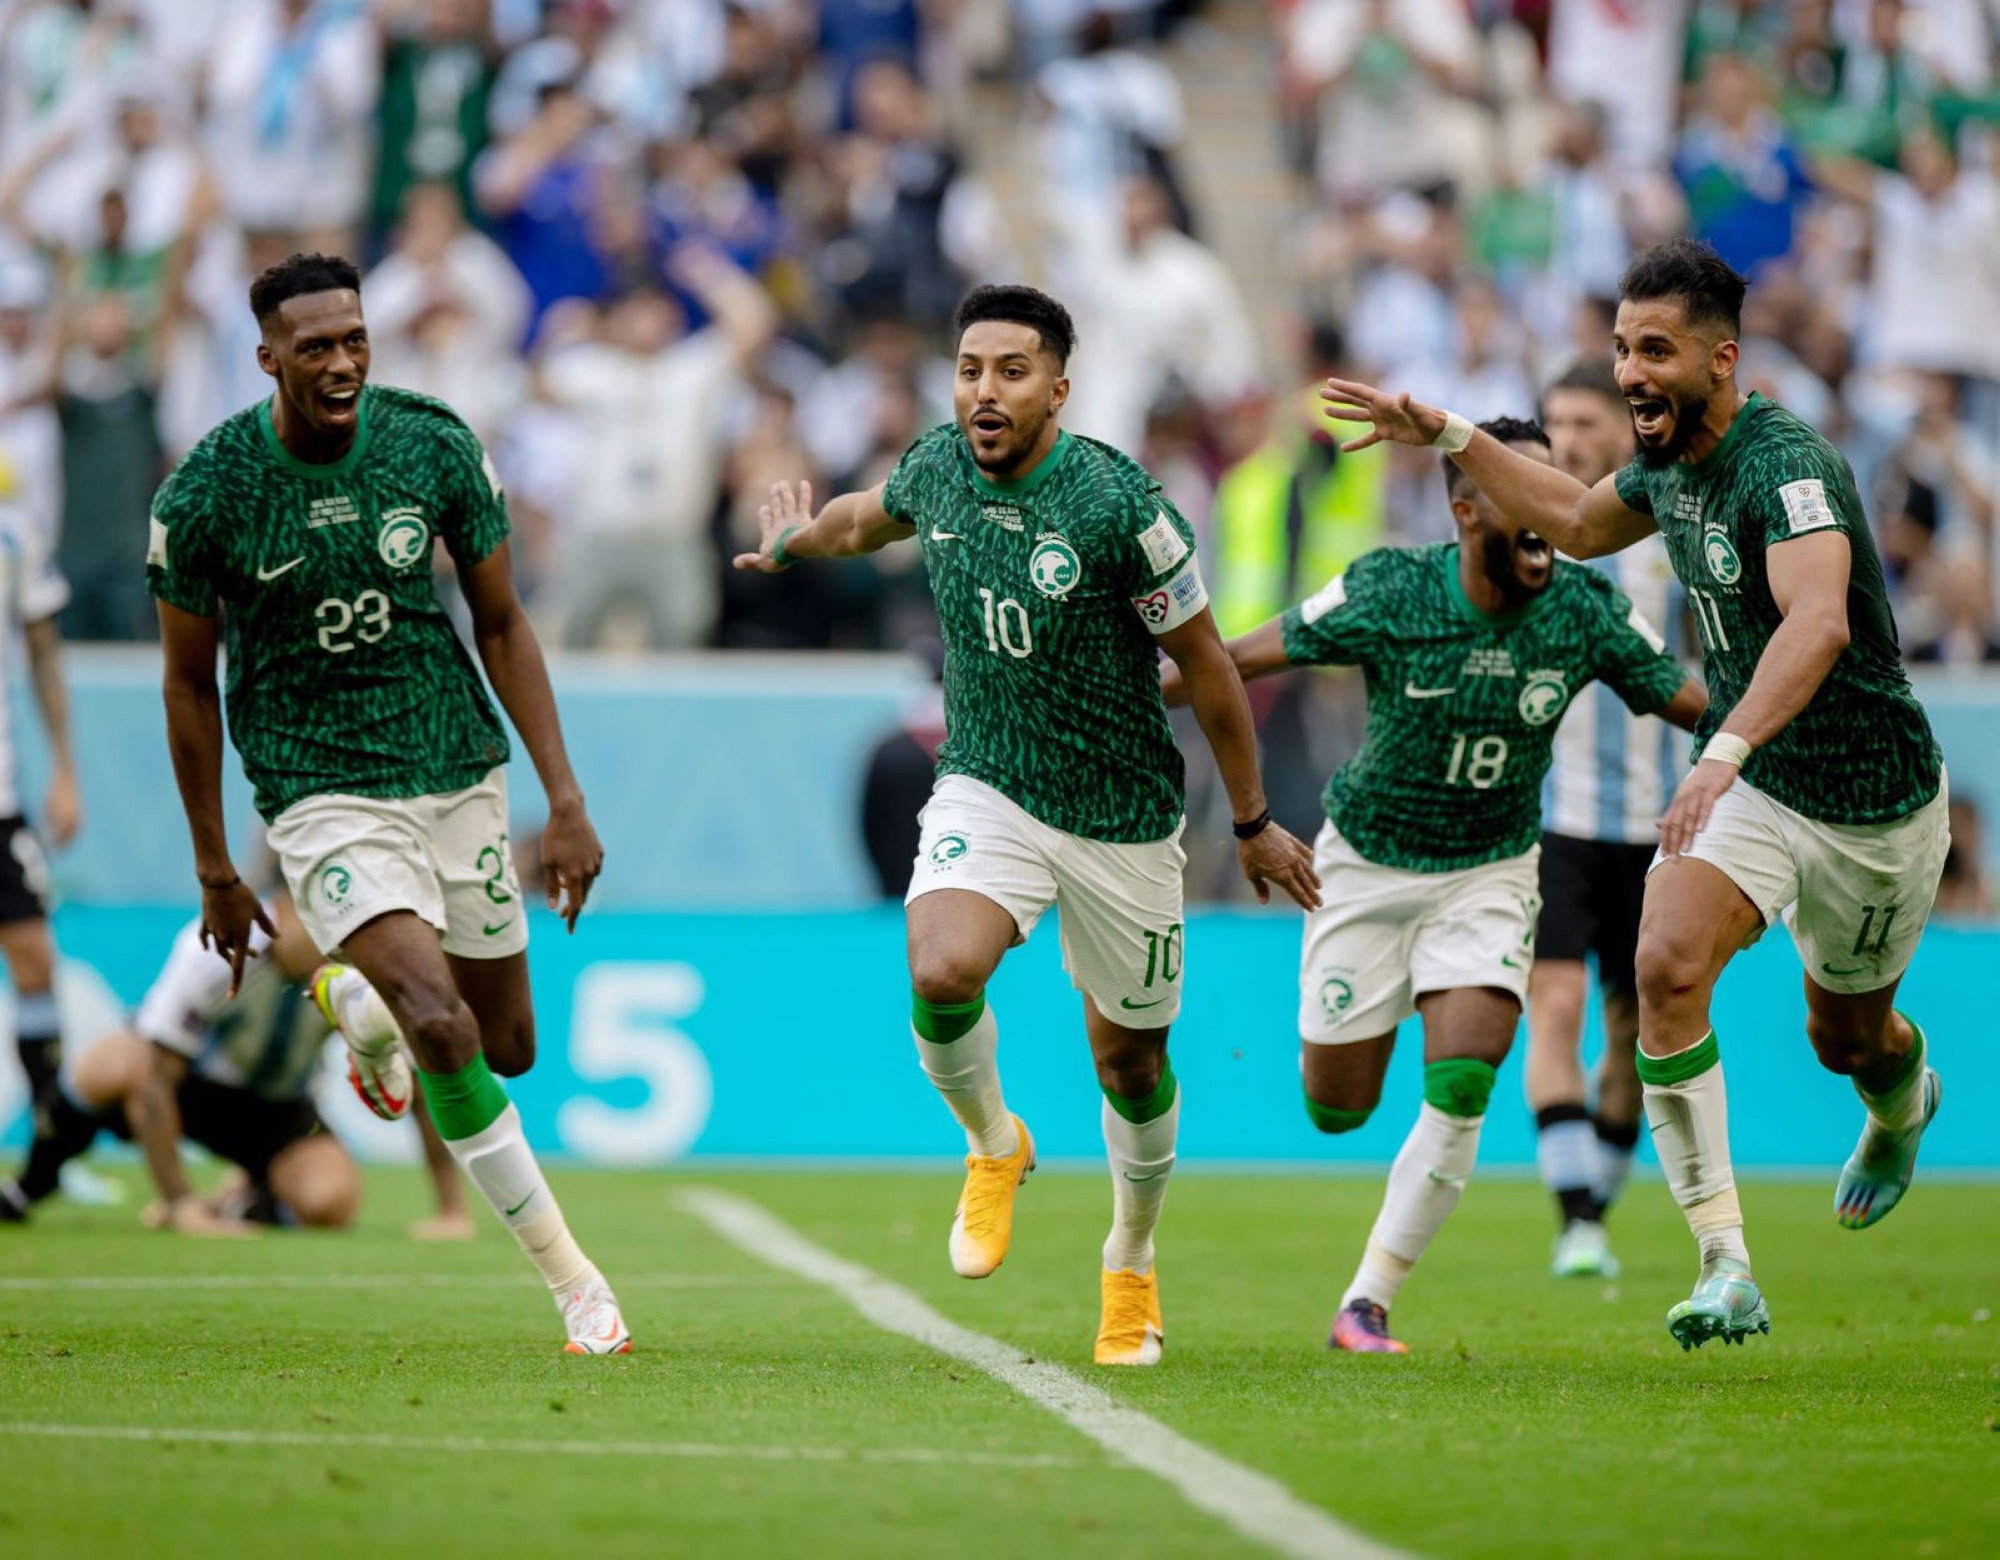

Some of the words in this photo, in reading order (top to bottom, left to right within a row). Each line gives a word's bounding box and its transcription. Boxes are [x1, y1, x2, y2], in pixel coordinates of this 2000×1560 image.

[315, 589, 391, 653] 23
[979, 588, 1033, 658] 10
[1689, 587, 1730, 652] 11
[1445, 733, 1508, 789] 18
[1143, 923, 1182, 988] 10
[1852, 906, 1898, 956] 11
